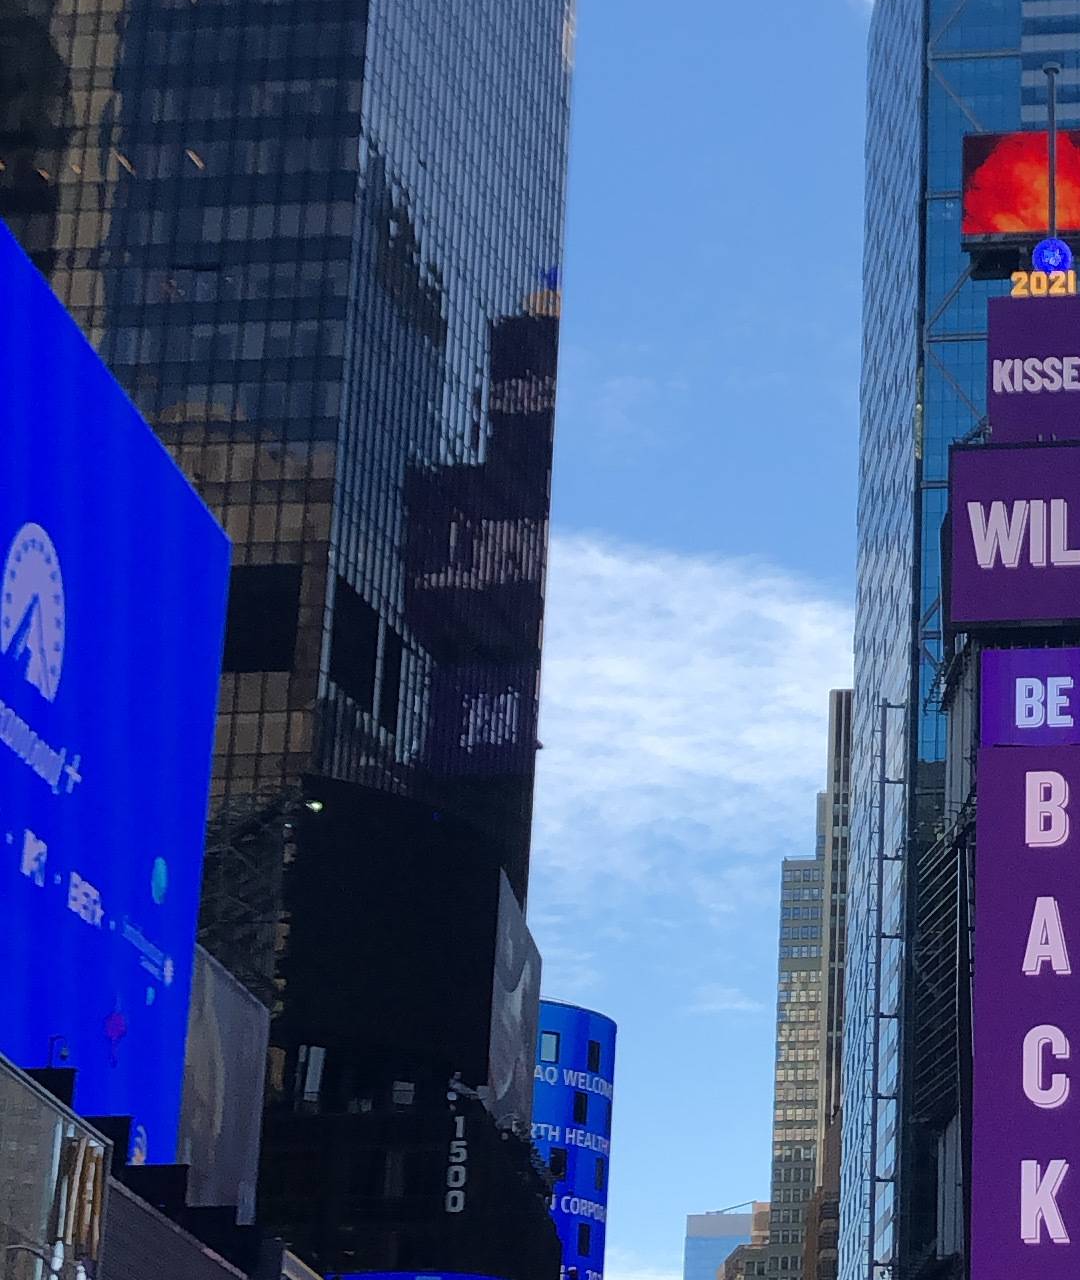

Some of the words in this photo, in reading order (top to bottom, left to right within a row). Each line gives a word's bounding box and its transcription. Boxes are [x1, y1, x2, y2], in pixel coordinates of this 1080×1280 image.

[1010, 270, 1077, 298] 2021
[1014, 676, 1074, 729] BE
[444, 1116, 468, 1213] 1500
